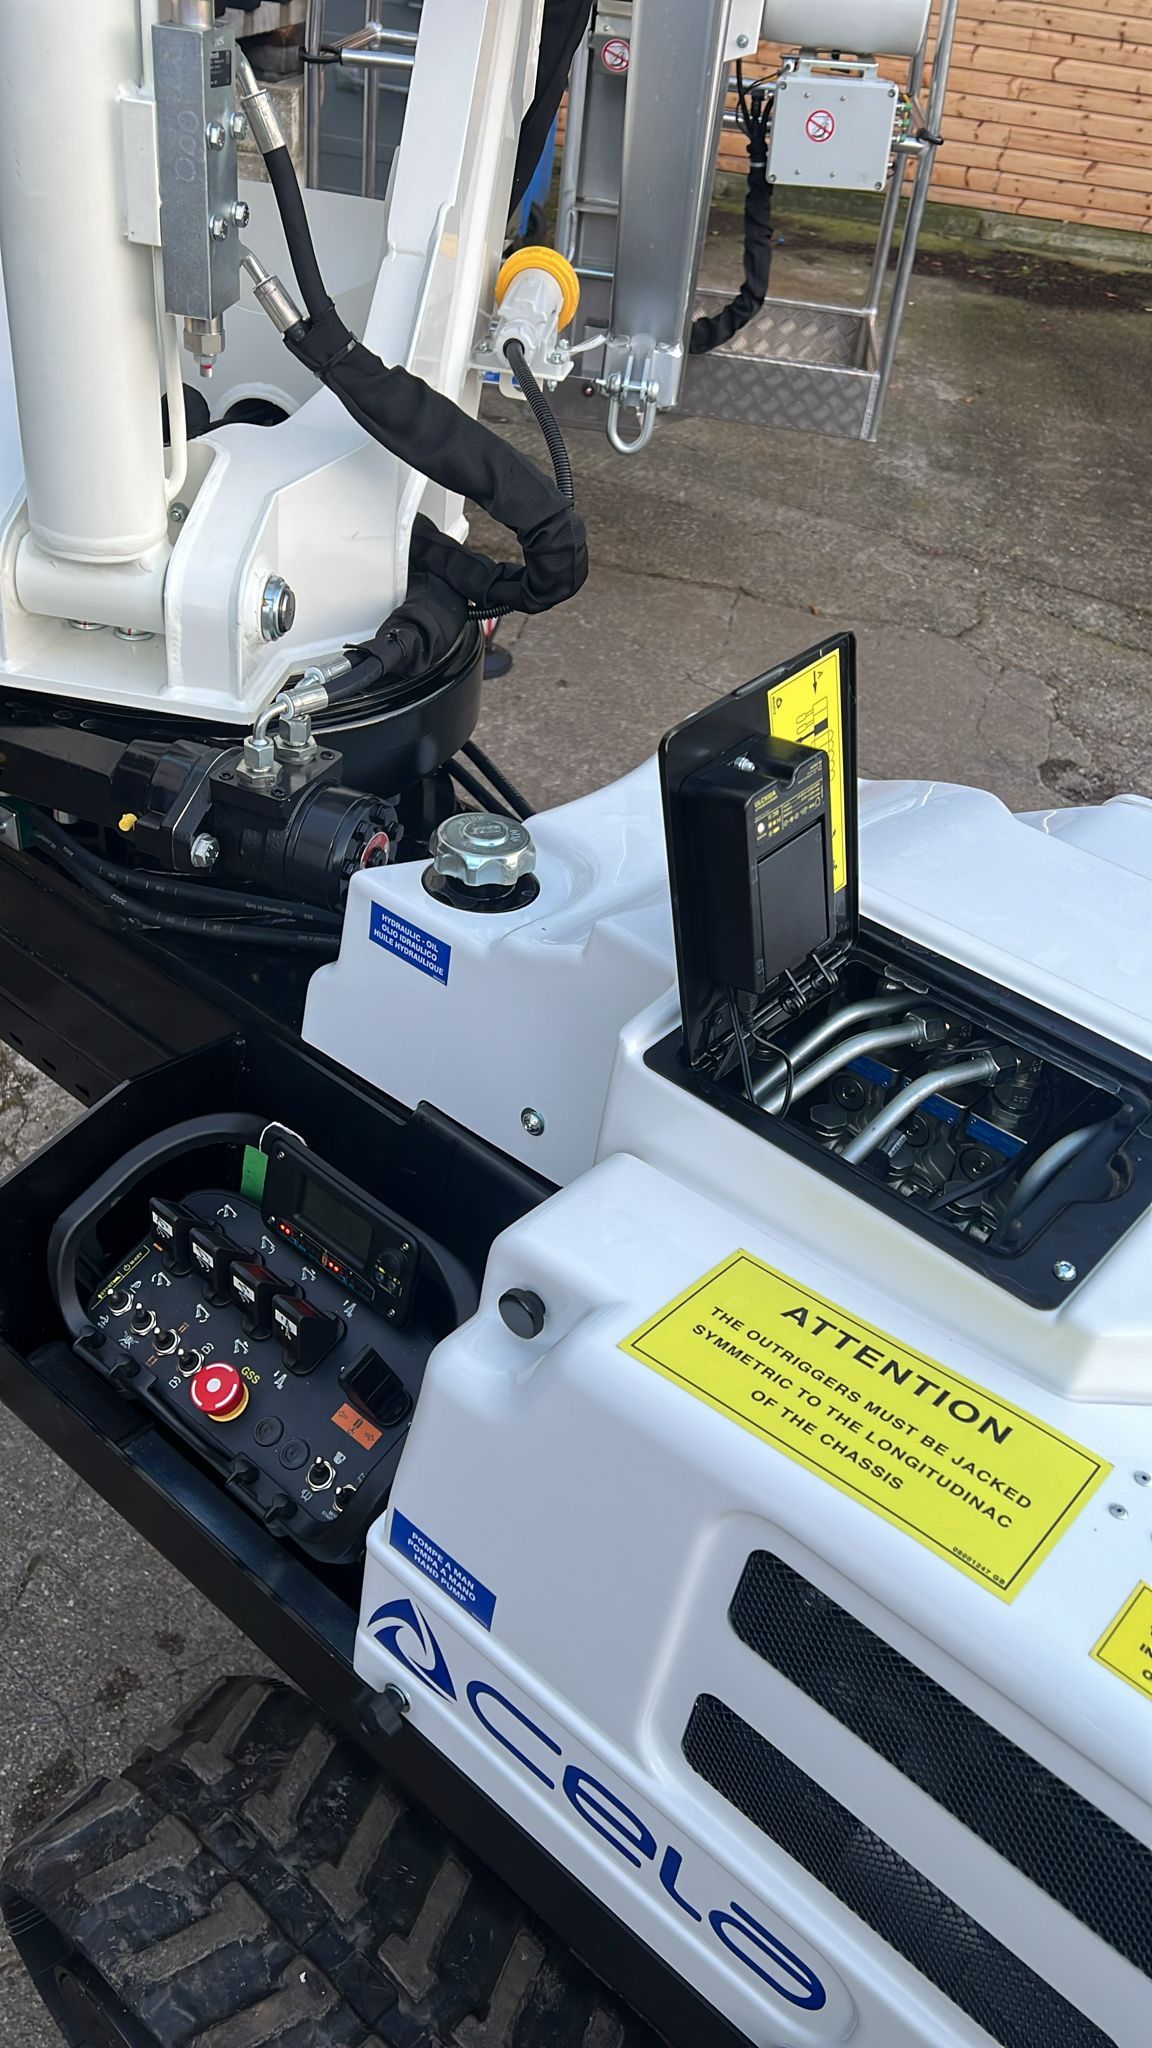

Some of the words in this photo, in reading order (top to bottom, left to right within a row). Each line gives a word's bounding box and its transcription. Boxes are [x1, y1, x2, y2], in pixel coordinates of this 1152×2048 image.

[374, 929, 394, 946] HUILE
[394, 941, 444, 976] HYDRAULIQUE
[381, 924, 398, 938] OLIO
[399, 934, 437, 962] IDRAULICO
[382, 914, 420, 942] HYDRAULIC
[426, 939, 438, 953] OIL
[241, 1366, 260, 1384] GSS
[780, 1306, 1013, 1445] ATTENTION
[692, 1324, 793, 1389] SYMMETRIC
[797, 1387, 822, 1407] TO
[826, 1405, 863, 1434] THE
[864, 1431, 1013, 1528] LONGITUDINAC
[711, 1306, 745, 1332] THE
[746, 1330, 862, 1403] OUTRIGGERS
[864, 1400, 919, 1436] MUST
[920, 1435, 949, 1456] BE
[951, 1456, 1032, 1509] JACKED
[751, 1390, 778, 1407] OF
[780, 1406, 818, 1435] THE
[820, 1433, 904, 1490] CHASSIS
[407, 1538, 438, 1569] POMPA
[440, 1568, 447, 1577] A
[448, 1574, 476, 1601] MANO
[412, 1532, 443, 1563] POMPE
[445, 1562, 452, 1571] A
[453, 1568, 474, 1591] MAN
[414, 1553, 439, 1578] HAND
[440, 1576, 467, 1602] PUMP
